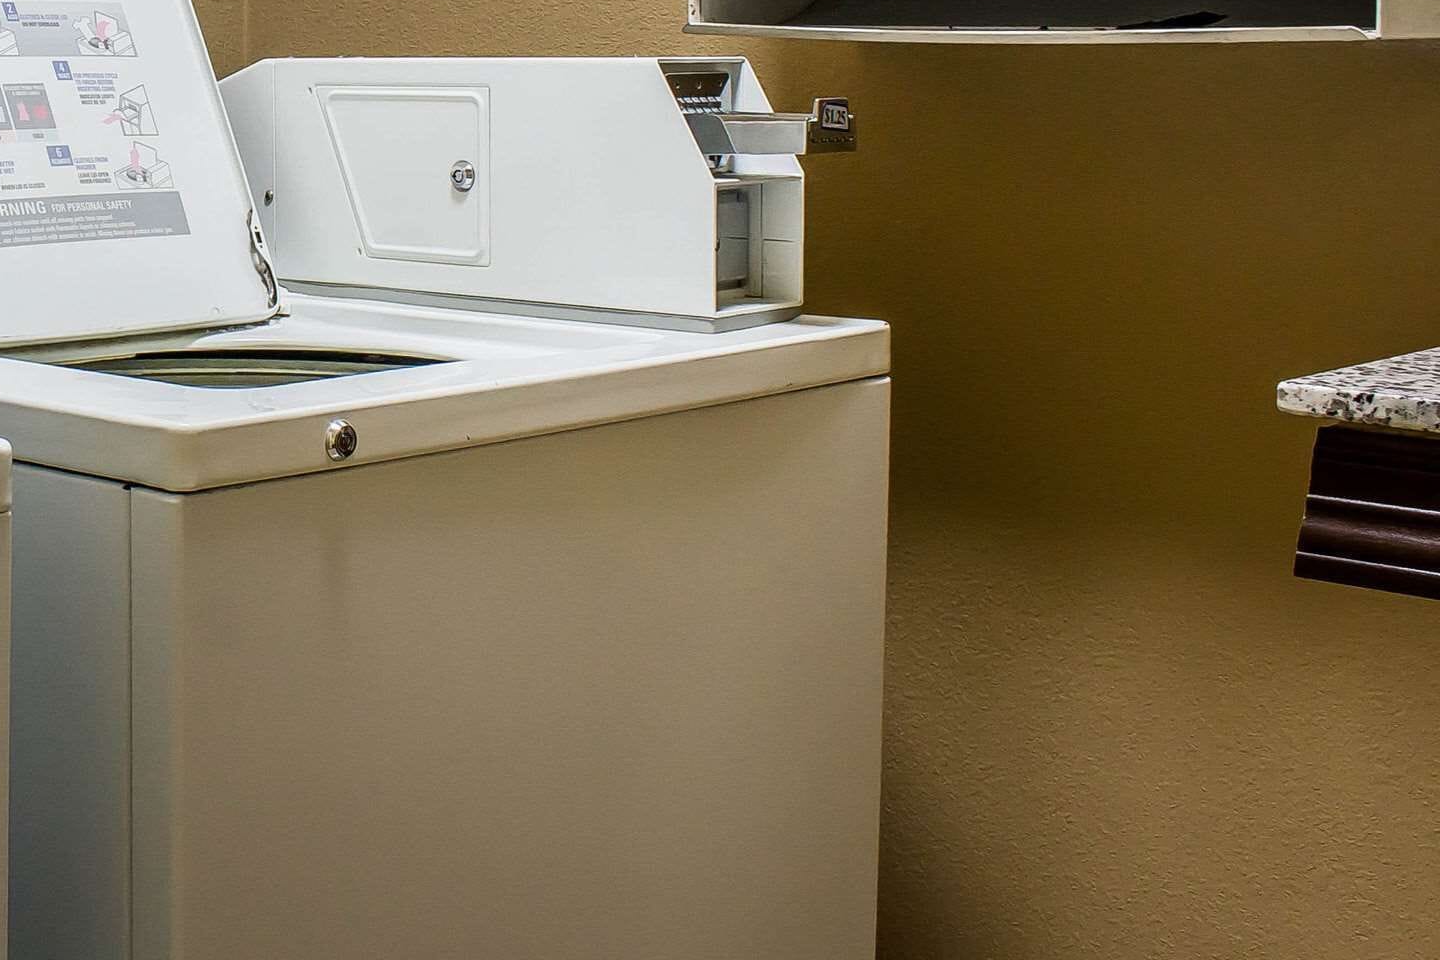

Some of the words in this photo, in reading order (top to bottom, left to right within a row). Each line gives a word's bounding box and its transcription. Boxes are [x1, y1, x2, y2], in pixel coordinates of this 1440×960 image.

[51, 203, 67, 213] FOR
[67, 200, 106, 212] PERSONAL
[106, 199, 133, 210] SAFETY
